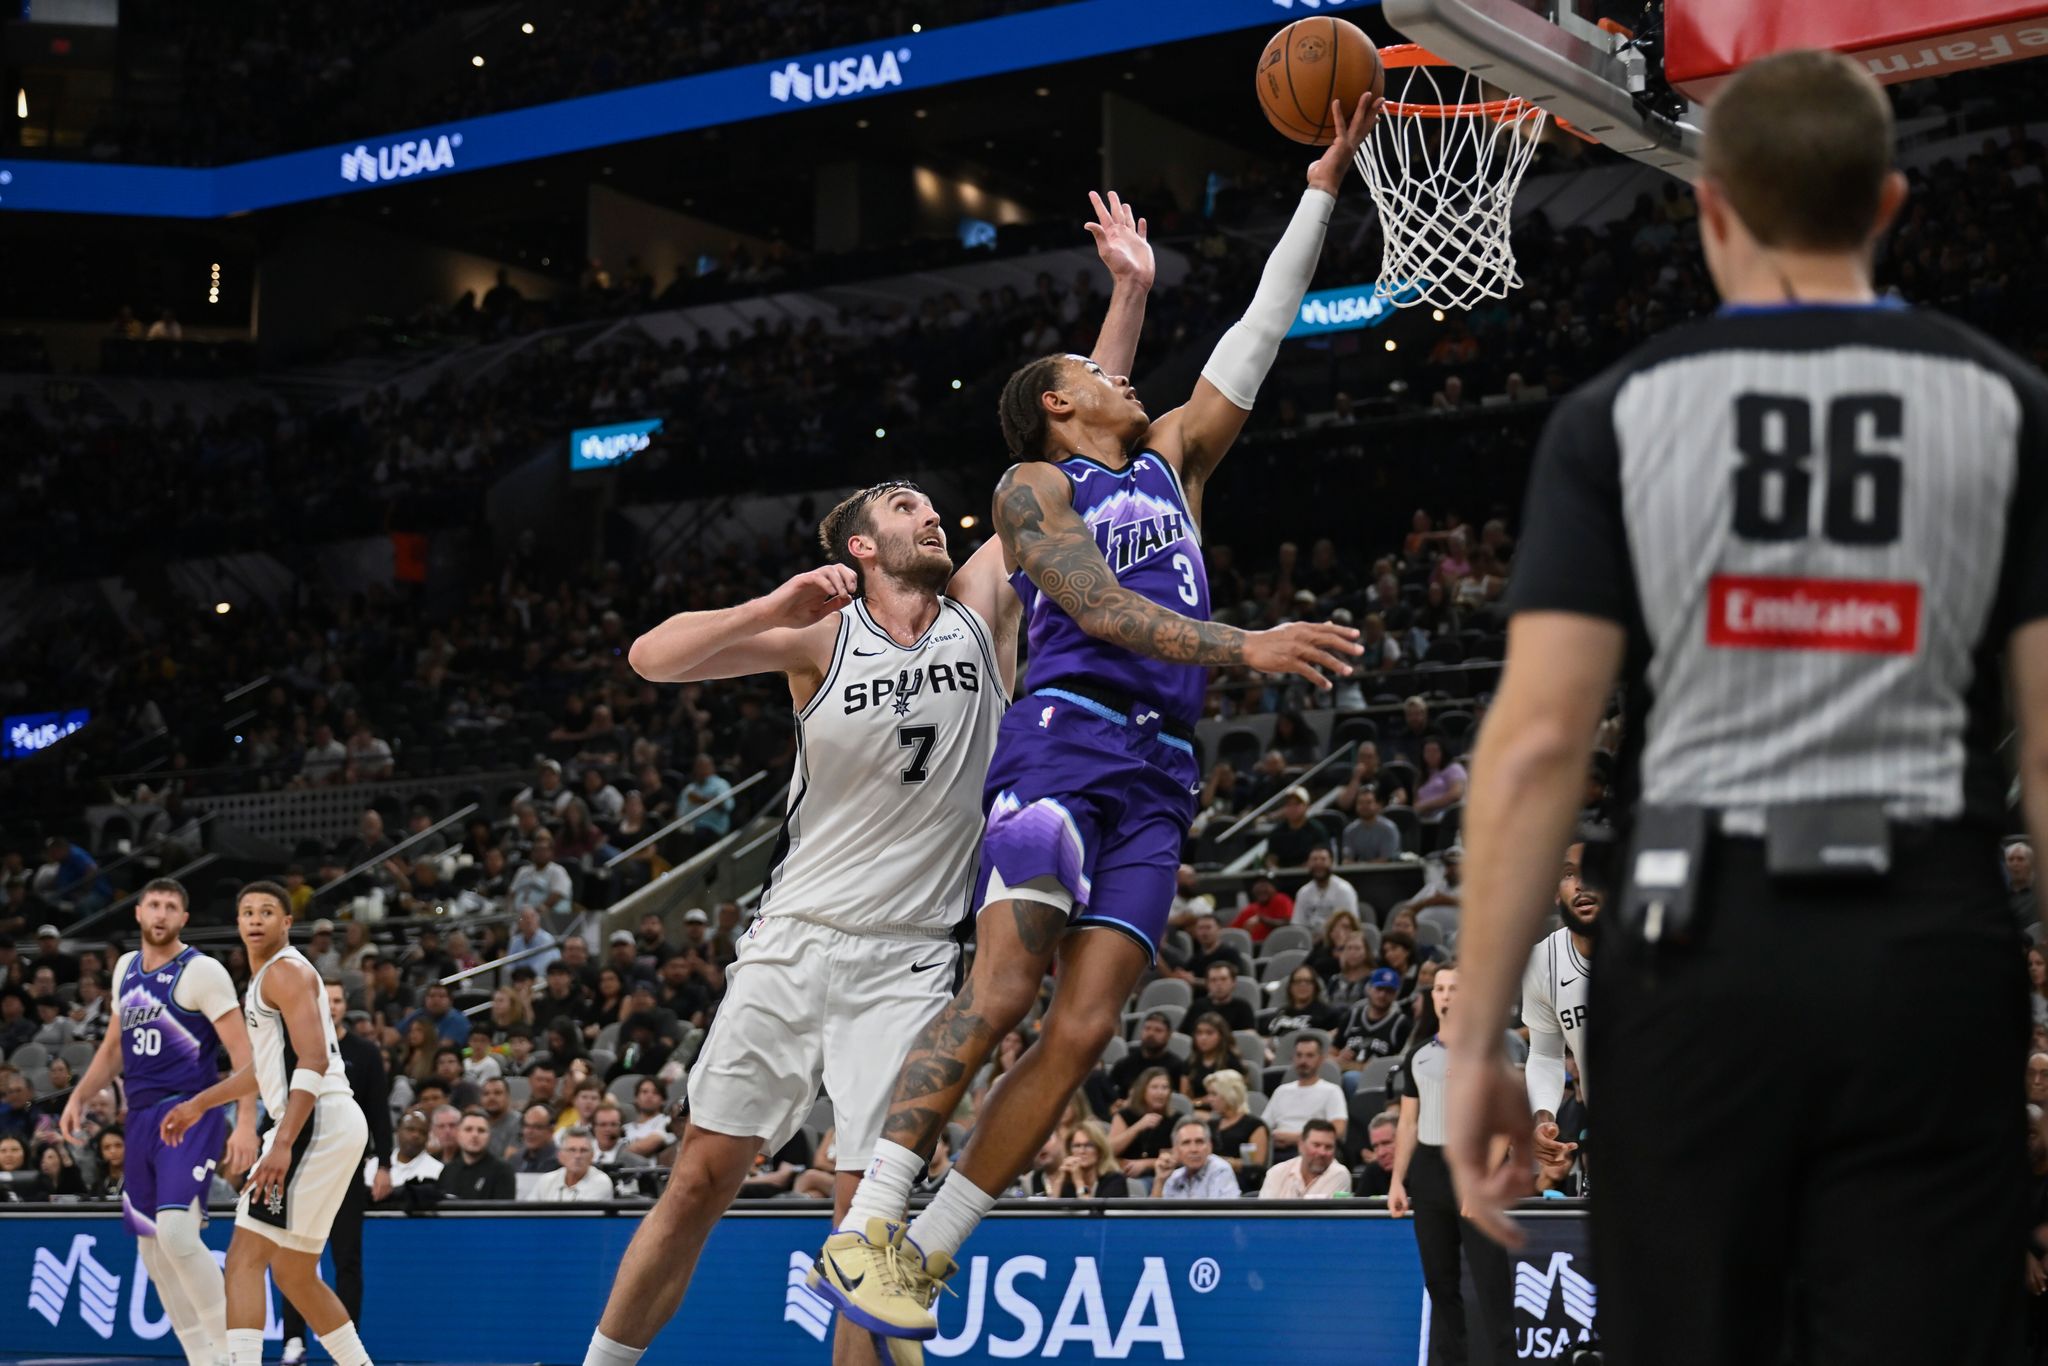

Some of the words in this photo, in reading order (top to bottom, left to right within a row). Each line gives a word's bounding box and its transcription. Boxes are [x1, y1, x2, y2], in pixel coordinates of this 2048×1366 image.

[1731, 392, 1904, 547] 86
[1172, 552, 1199, 607] 3
[1724, 589, 1903, 638] Emirates
[843, 661, 979, 717] SPURS
[897, 722, 939, 785] 7
[132, 1027, 162, 1057] 30
